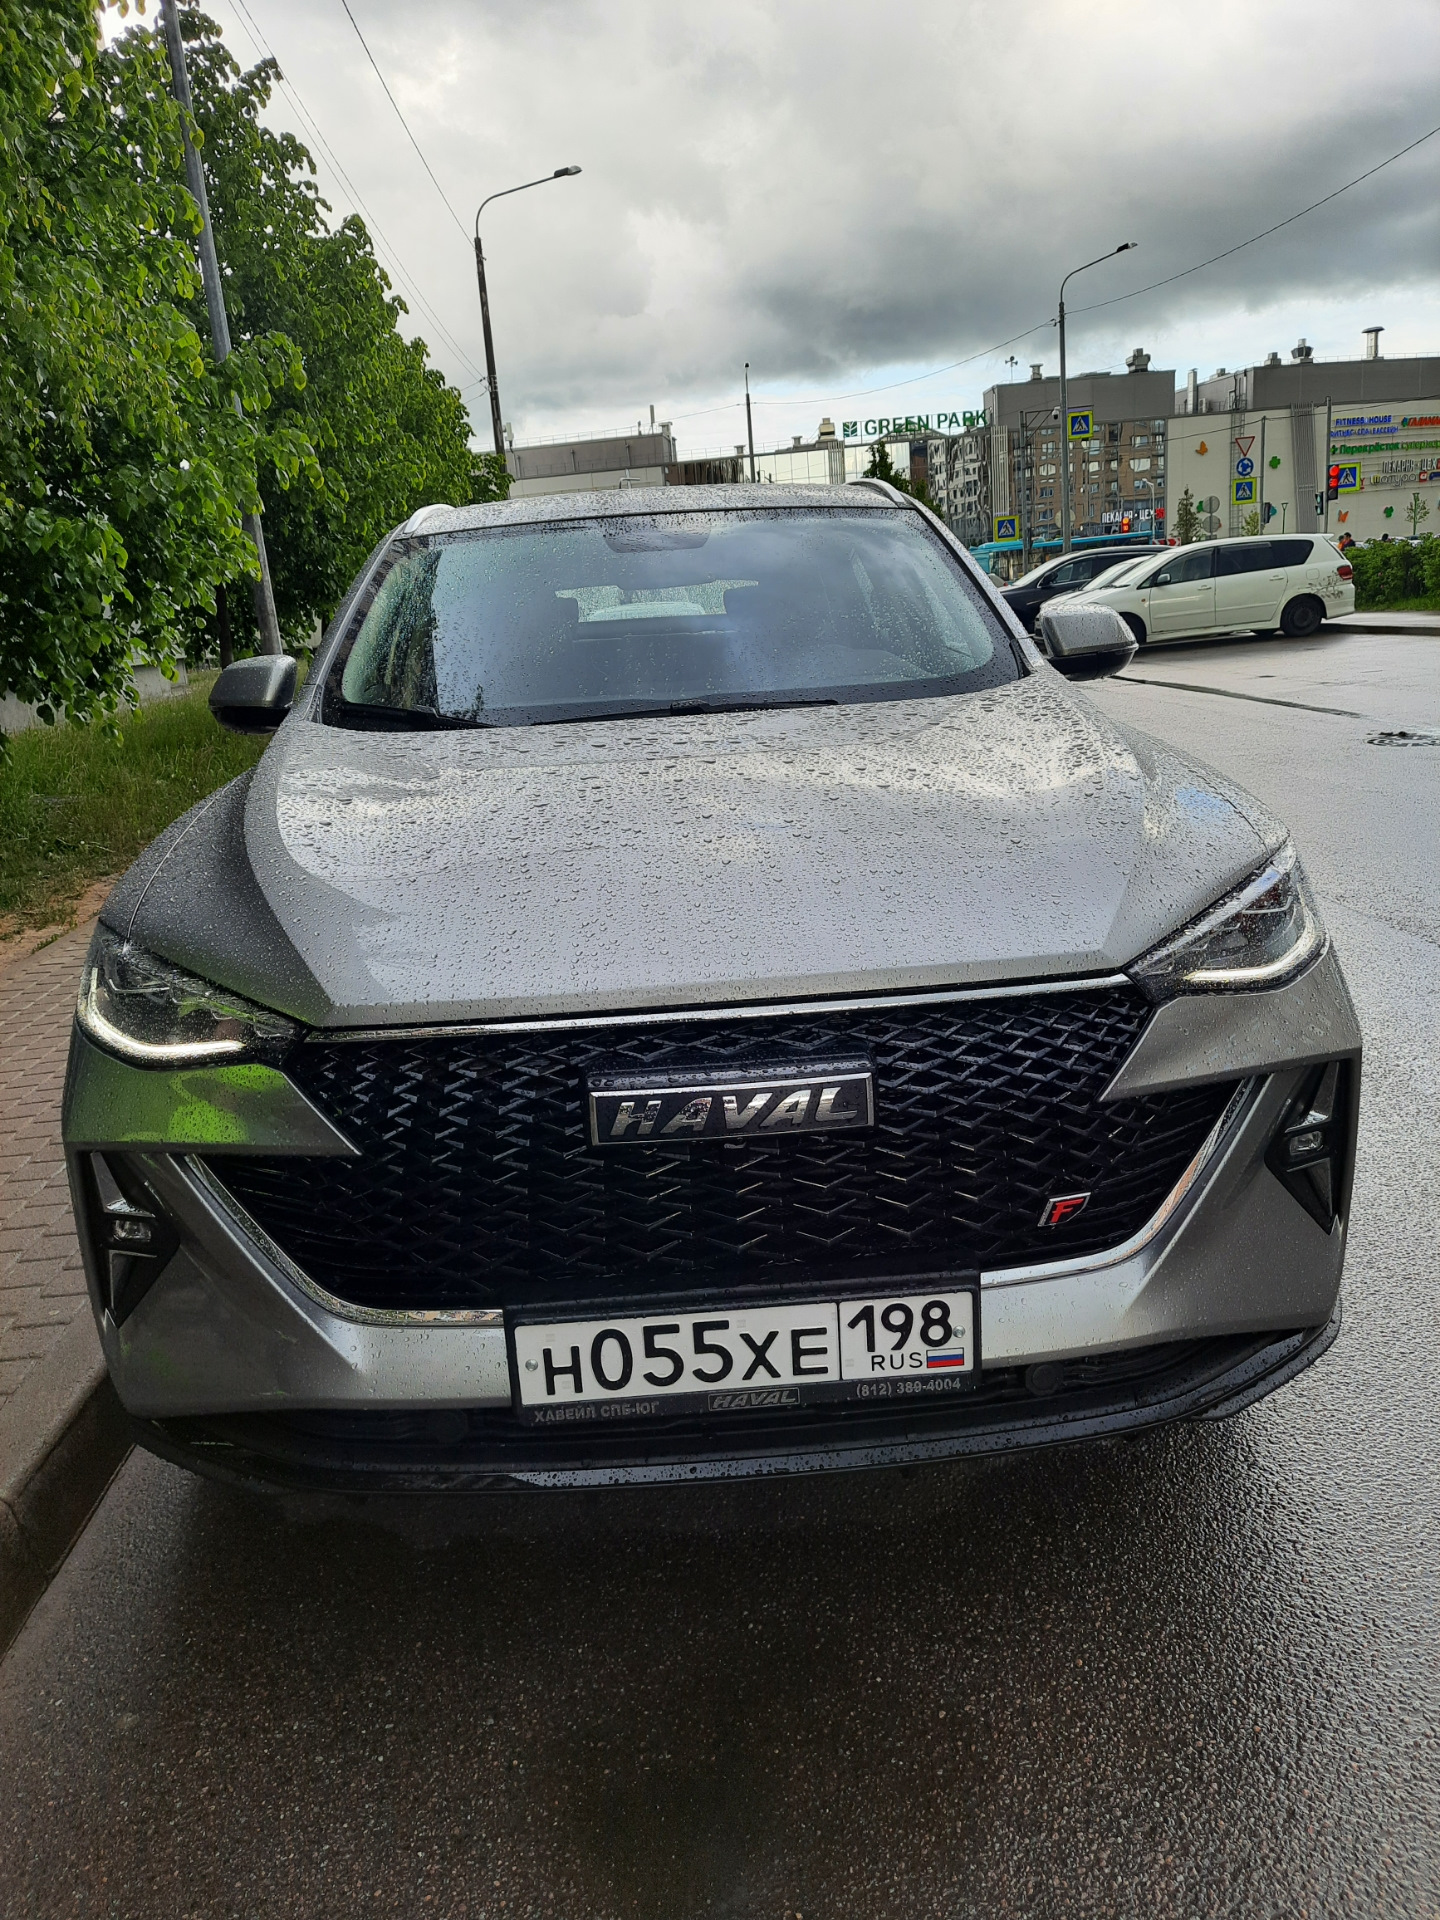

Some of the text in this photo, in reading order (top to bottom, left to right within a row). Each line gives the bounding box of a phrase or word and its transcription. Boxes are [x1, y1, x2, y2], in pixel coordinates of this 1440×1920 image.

[864, 409, 988, 436] GREEN PARK
[1335, 414, 1392, 426] FITNESS HOUSE
[1382, 459, 1415, 474] ПЕКАРНЯ
[610, 1086, 858, 1136] HAVAL
[1050, 1197, 1085, 1223] F
[847, 1300, 953, 1352] 198
[542, 1319, 829, 1396] Н055ХЕ
[871, 1352, 923, 1371] RUS
[711, 1390, 797, 1410] HAVAL
[856, 1381, 892, 1399] (812)
[534, 1405, 596, 1423] ХАВЕЙЛ
